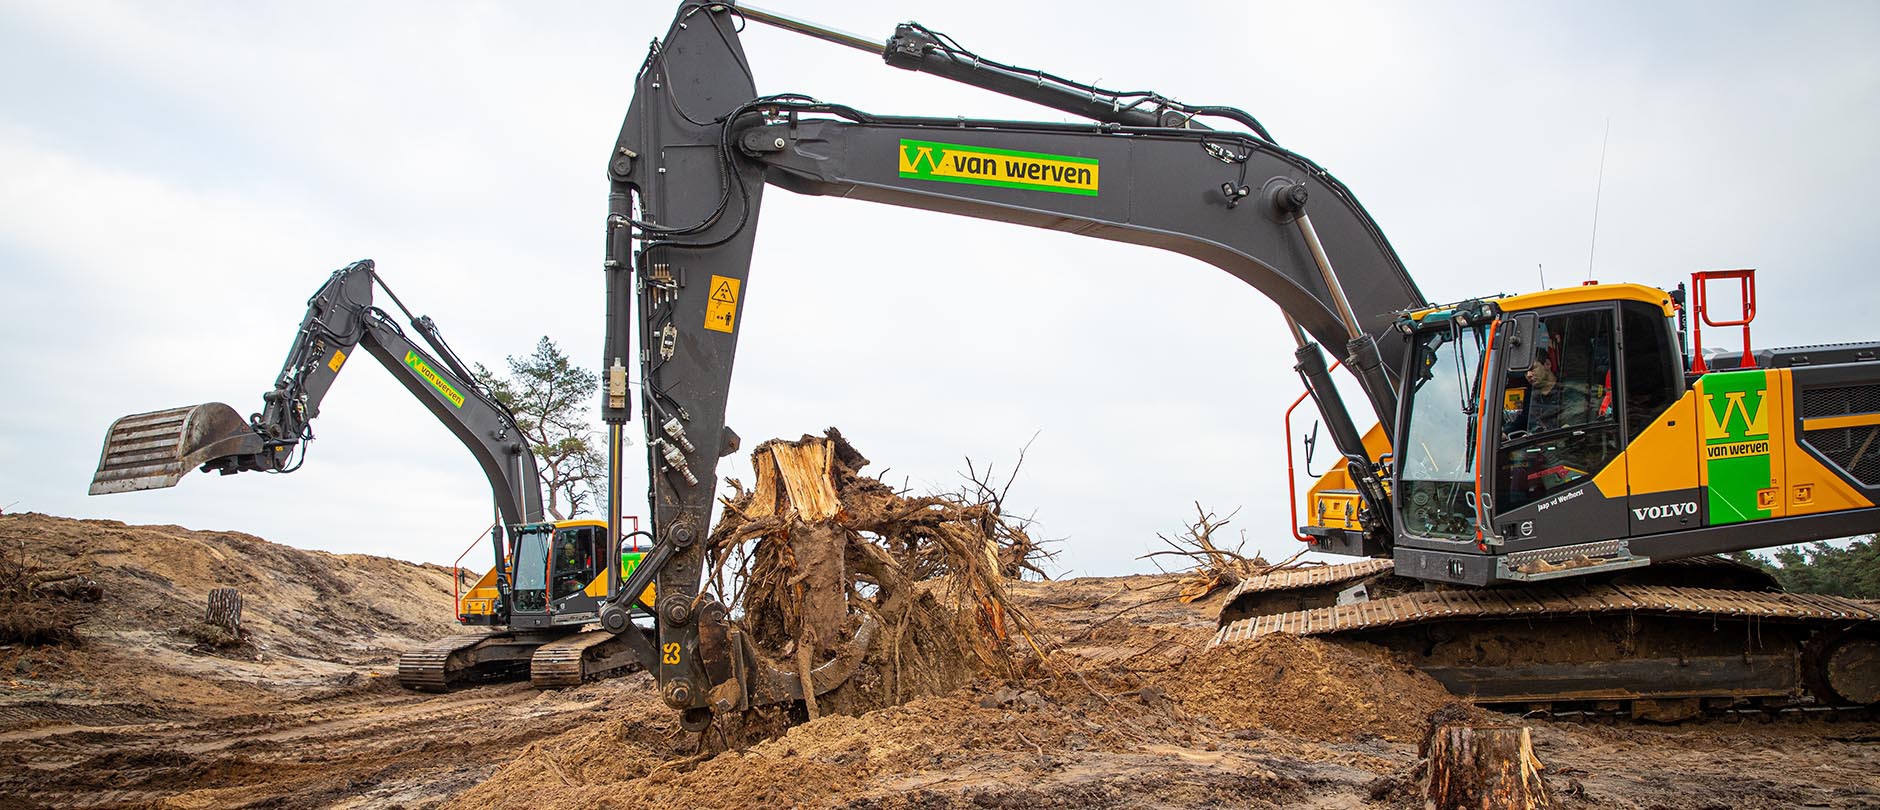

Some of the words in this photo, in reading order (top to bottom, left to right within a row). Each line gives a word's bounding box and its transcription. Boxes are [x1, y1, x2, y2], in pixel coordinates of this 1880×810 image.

[953, 155, 997, 177] van
[1004, 160, 1092, 185] werven
[421, 366, 435, 381] van
[435, 379, 461, 404] werven
[1708, 445, 1728, 458] van
[1730, 441, 1769, 455] werven
[1537, 502, 1550, 512] Jaap
[1632, 502, 1698, 521] VOLVO
